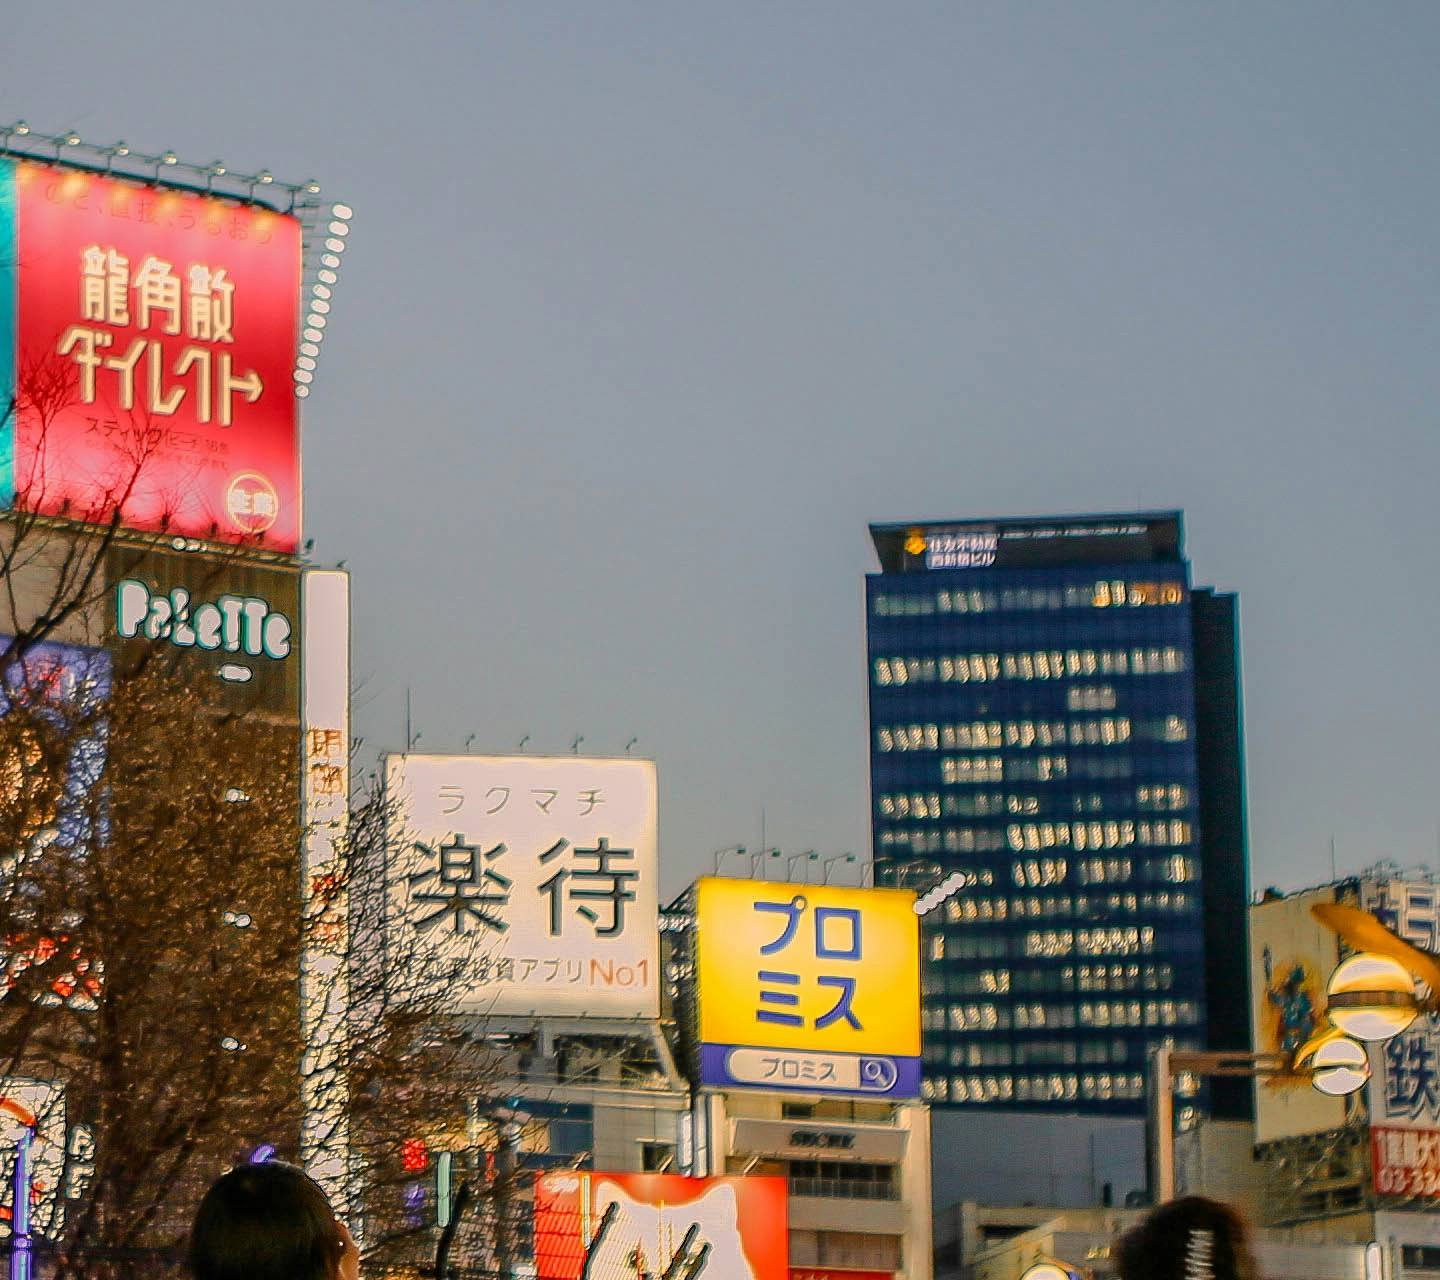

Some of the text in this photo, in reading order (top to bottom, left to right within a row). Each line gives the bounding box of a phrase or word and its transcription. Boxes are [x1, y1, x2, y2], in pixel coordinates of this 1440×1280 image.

[78, 244, 236, 345] 龍角散
[58, 326, 264, 427] ダイレクト
[439, 785, 607, 816] ラクマチ
[408, 833, 641, 938] 楽待
[753, 894, 864, 961] プロ
[756, 970, 863, 1033] ミス
[760, 1058, 837, 1082] プロミス
